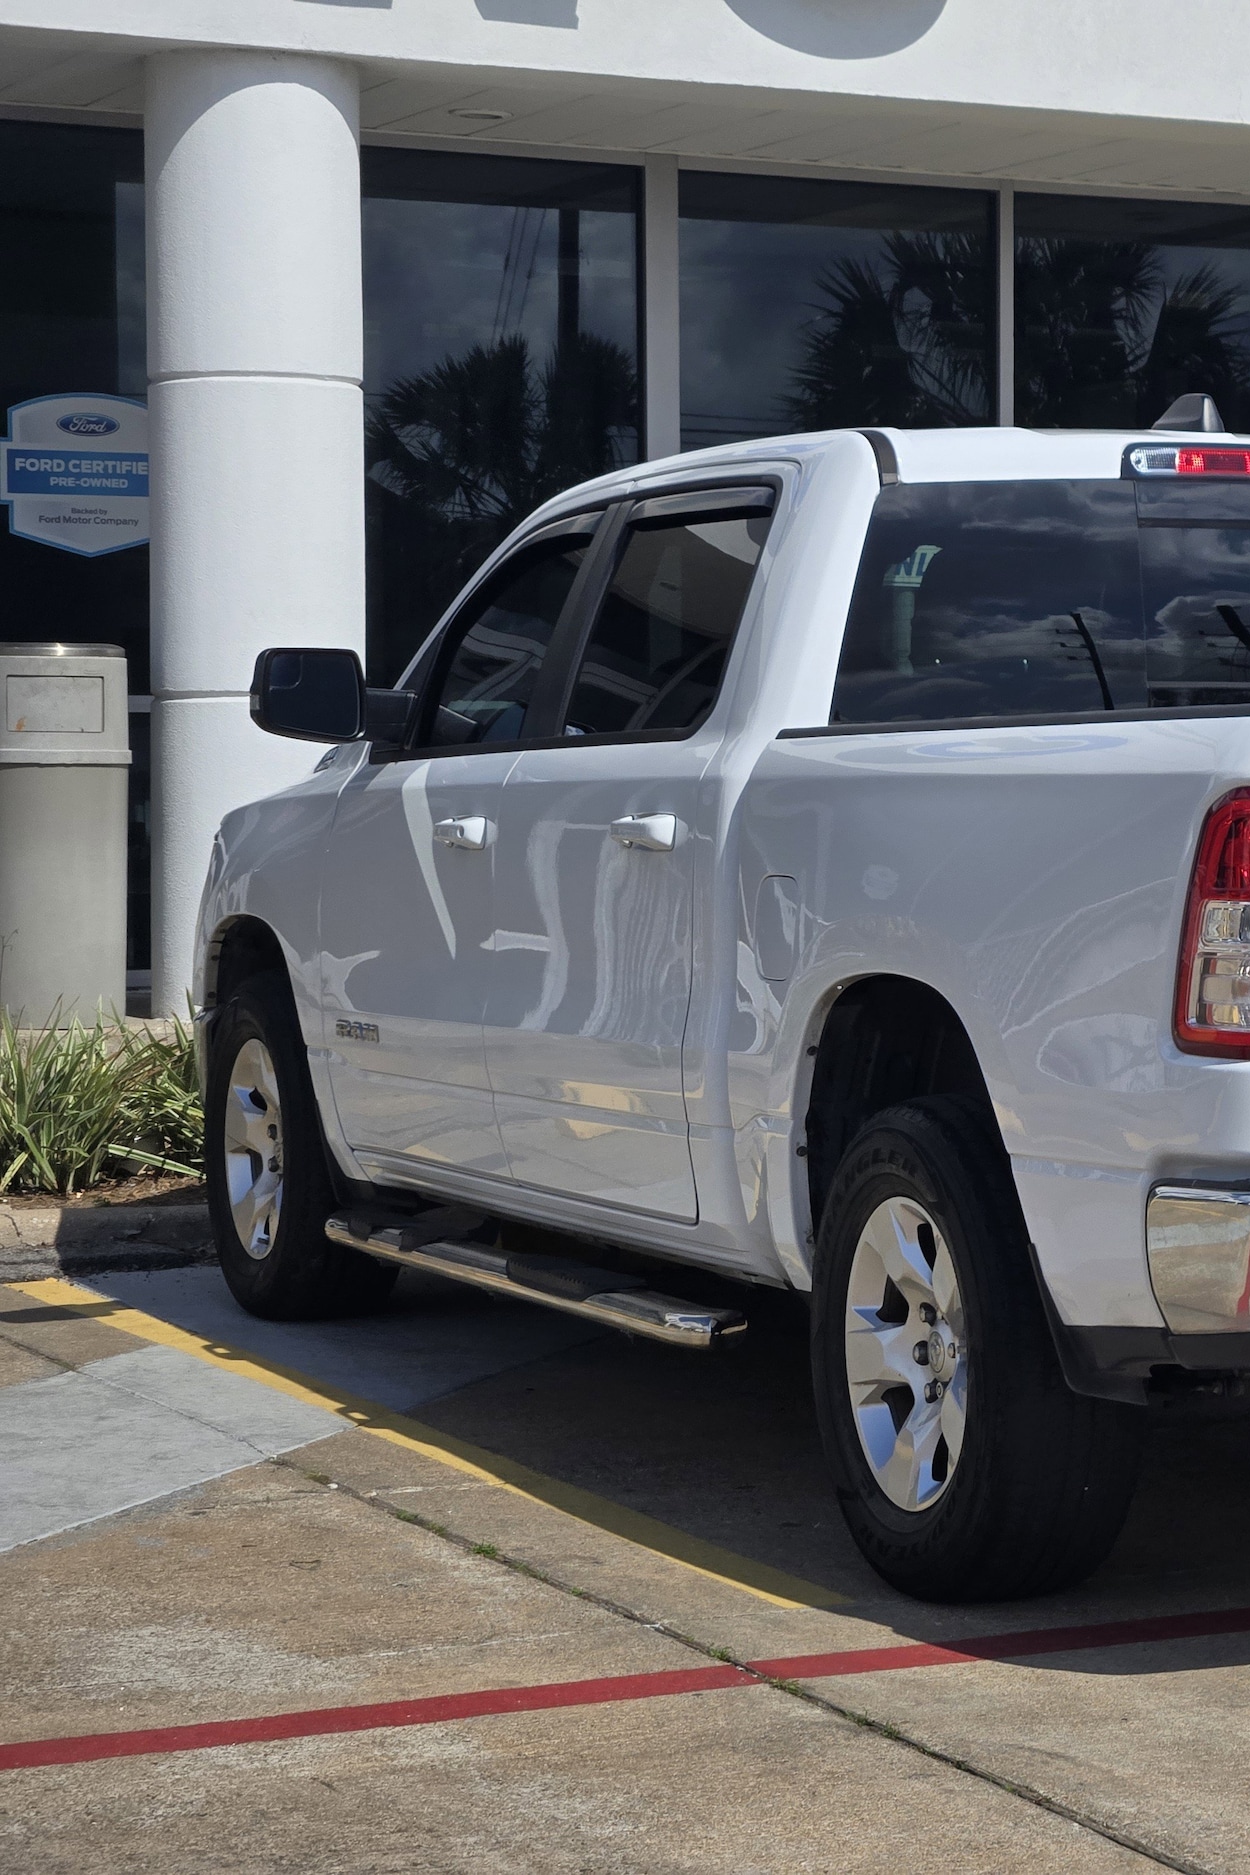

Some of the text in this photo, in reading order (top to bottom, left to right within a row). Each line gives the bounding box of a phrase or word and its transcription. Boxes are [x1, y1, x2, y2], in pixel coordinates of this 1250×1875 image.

[69, 416, 107, 432] Ford
[15, 458, 148, 475] FORD CERTIFIE
[50, 477, 129, 489] PRE-OWNED
[71, 507, 108, 516] Backed by
[39, 515, 139, 527] Ford Motor Company
